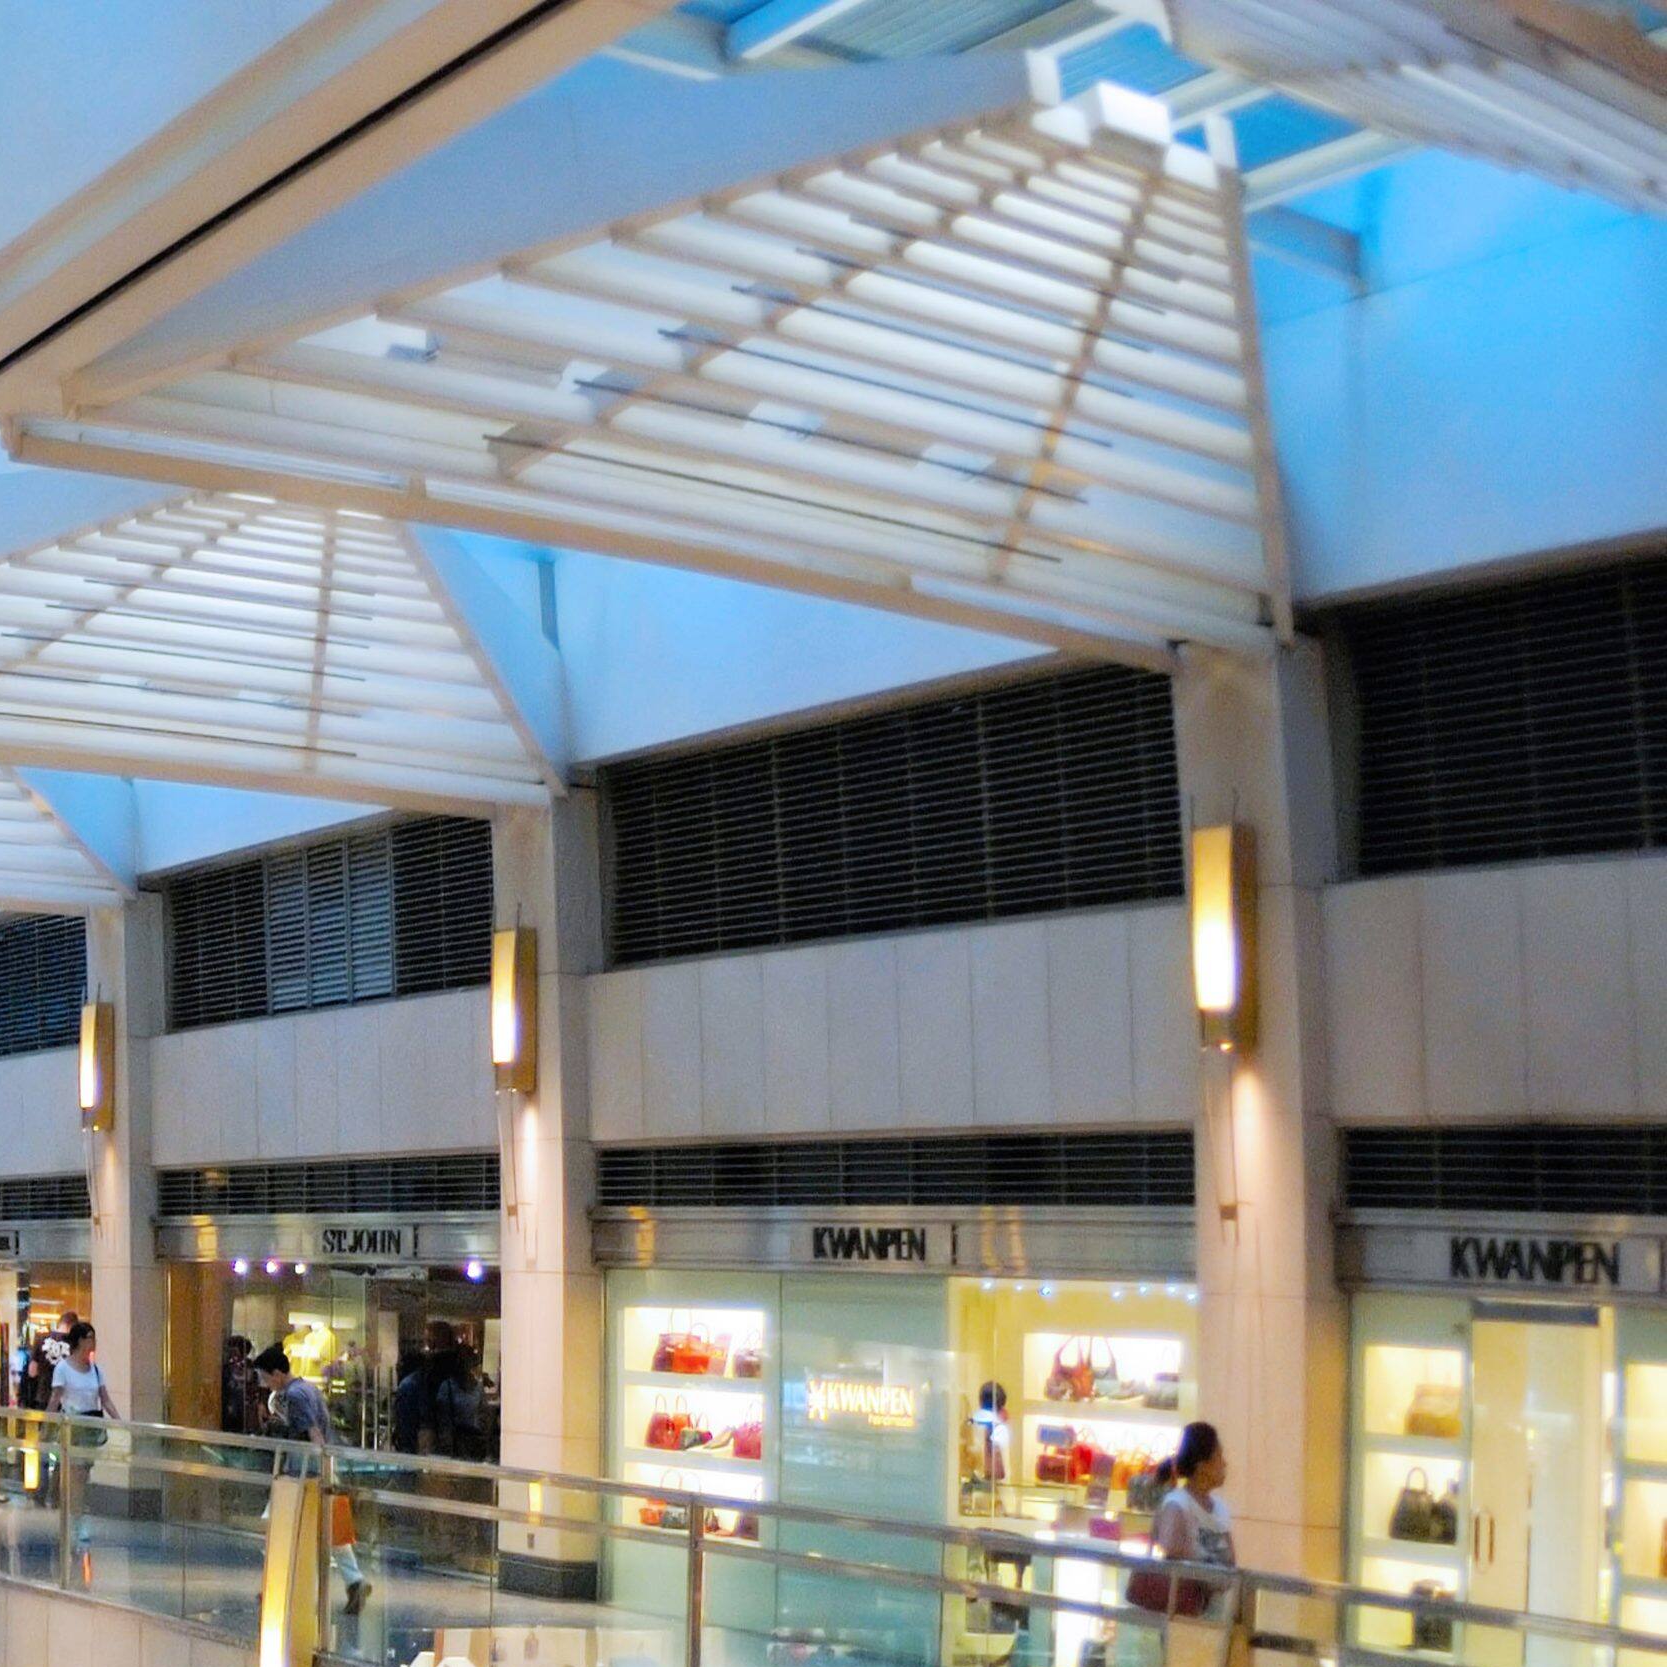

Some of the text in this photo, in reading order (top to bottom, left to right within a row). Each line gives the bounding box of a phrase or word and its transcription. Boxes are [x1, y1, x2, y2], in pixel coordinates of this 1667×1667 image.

[813, 1226, 926, 1262] KWANPEN
[1450, 1235, 1621, 1285] KWANPEN
[826, 1380, 915, 1417] KWANPEN
